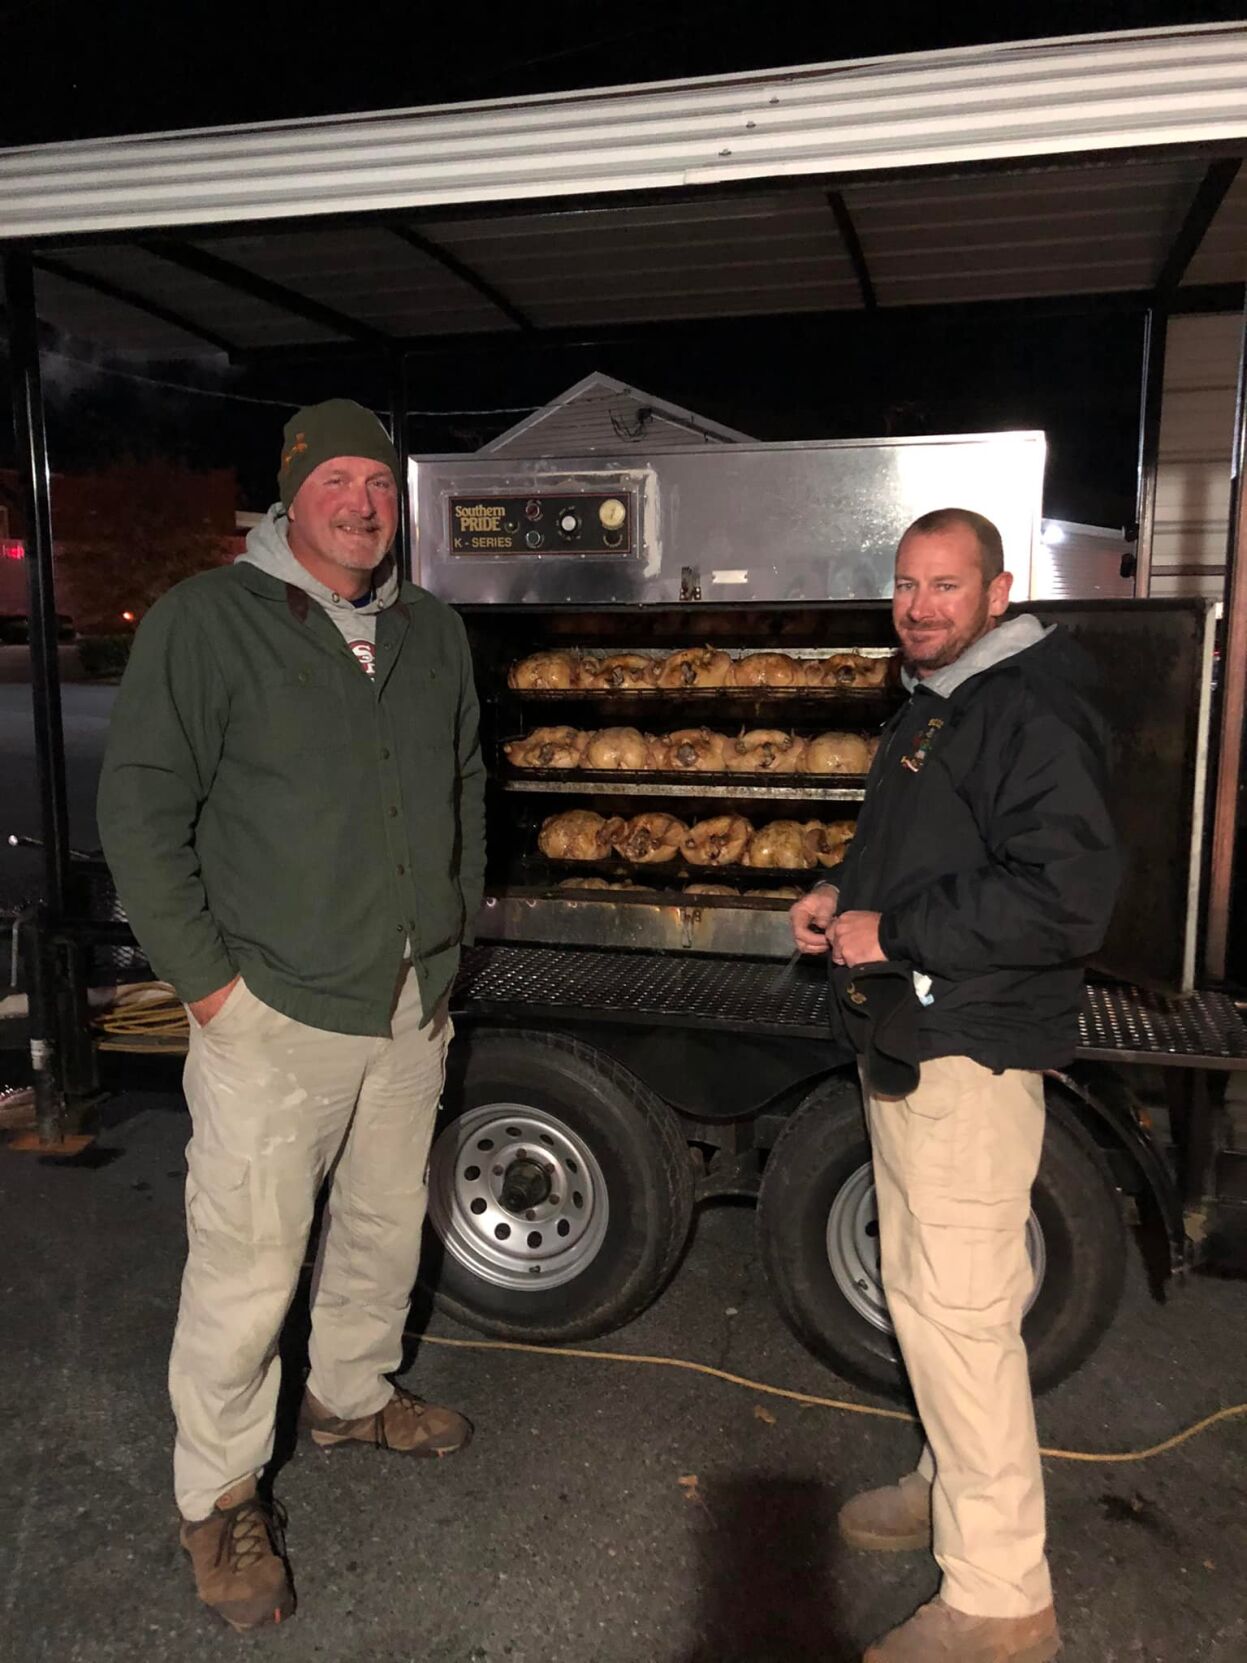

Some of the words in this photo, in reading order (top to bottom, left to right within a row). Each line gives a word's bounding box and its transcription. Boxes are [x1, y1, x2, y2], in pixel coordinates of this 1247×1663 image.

[455, 504, 506, 518] Southern
[460, 516, 502, 532] PRIDE
[471, 536, 513, 548] SERIES
